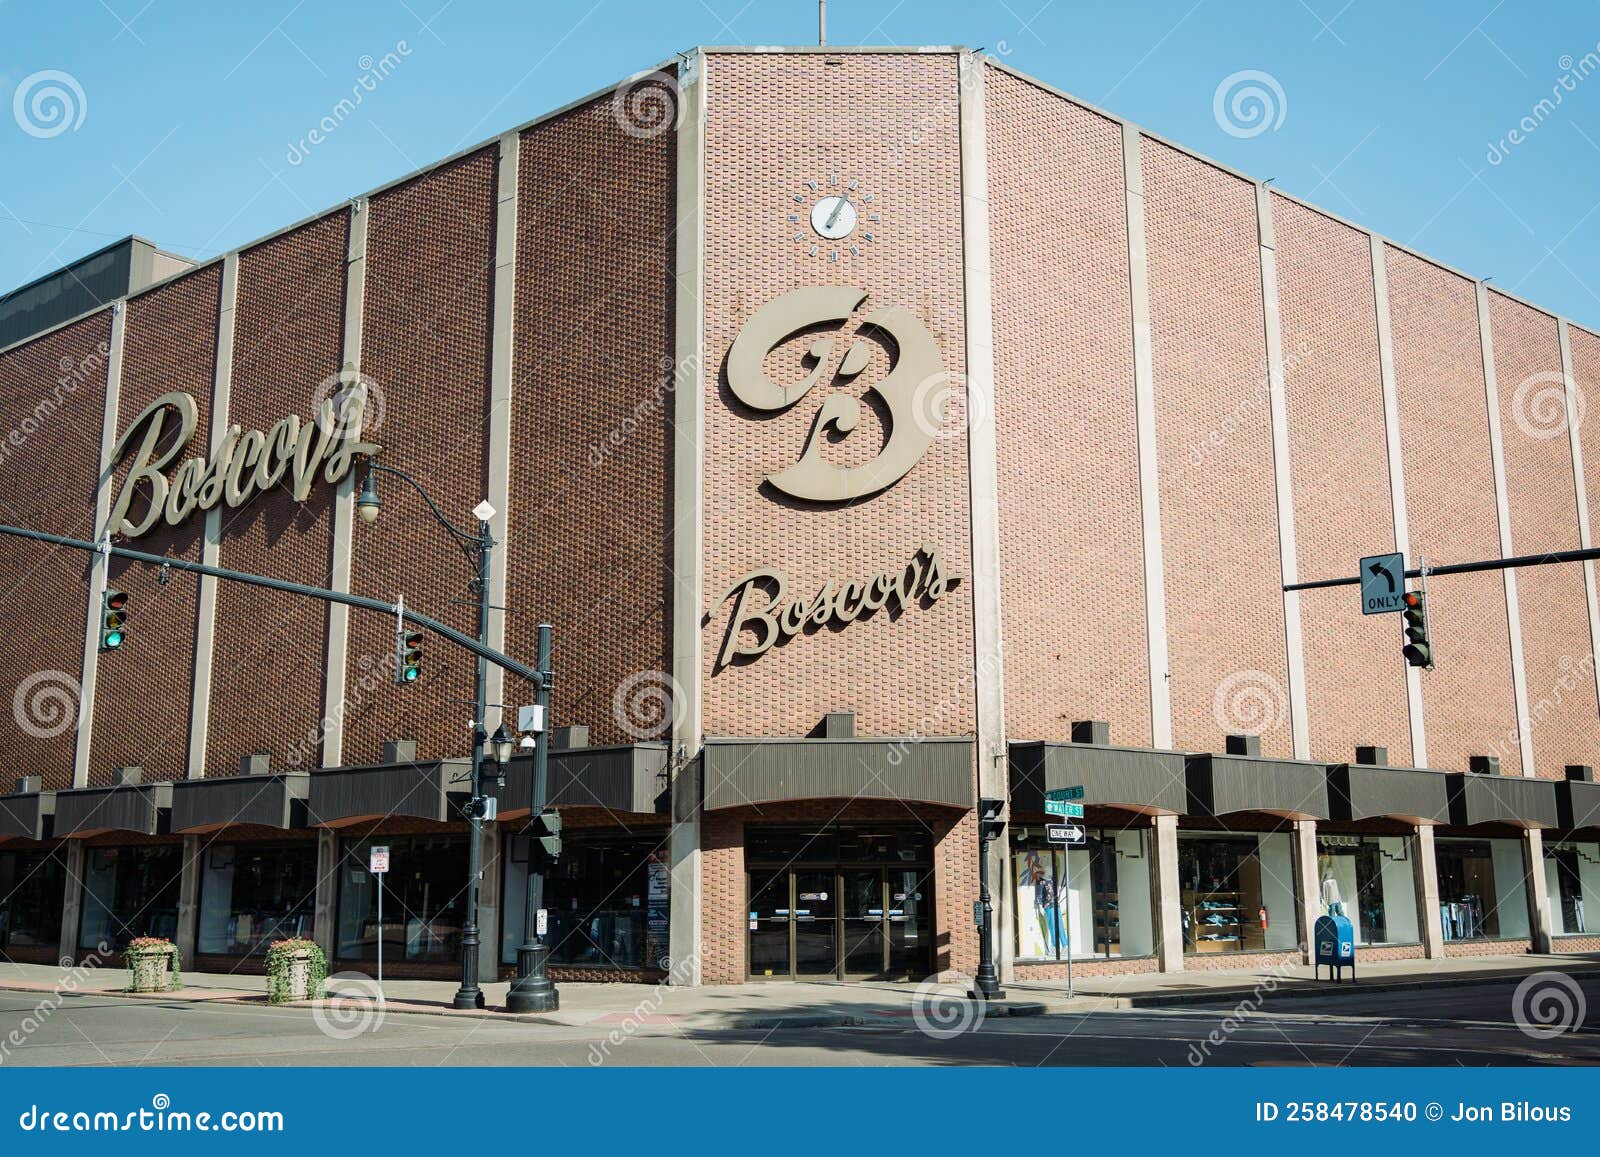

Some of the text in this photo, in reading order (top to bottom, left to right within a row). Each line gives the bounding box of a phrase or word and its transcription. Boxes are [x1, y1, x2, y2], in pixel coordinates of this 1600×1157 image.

[98, 361, 383, 538] Boscov's
[726, 286, 945, 502] B
[708, 542, 964, 667] Boscov's
[1368, 595, 1400, 609] ONLY
[1051, 829, 1074, 838] ONE WAY
